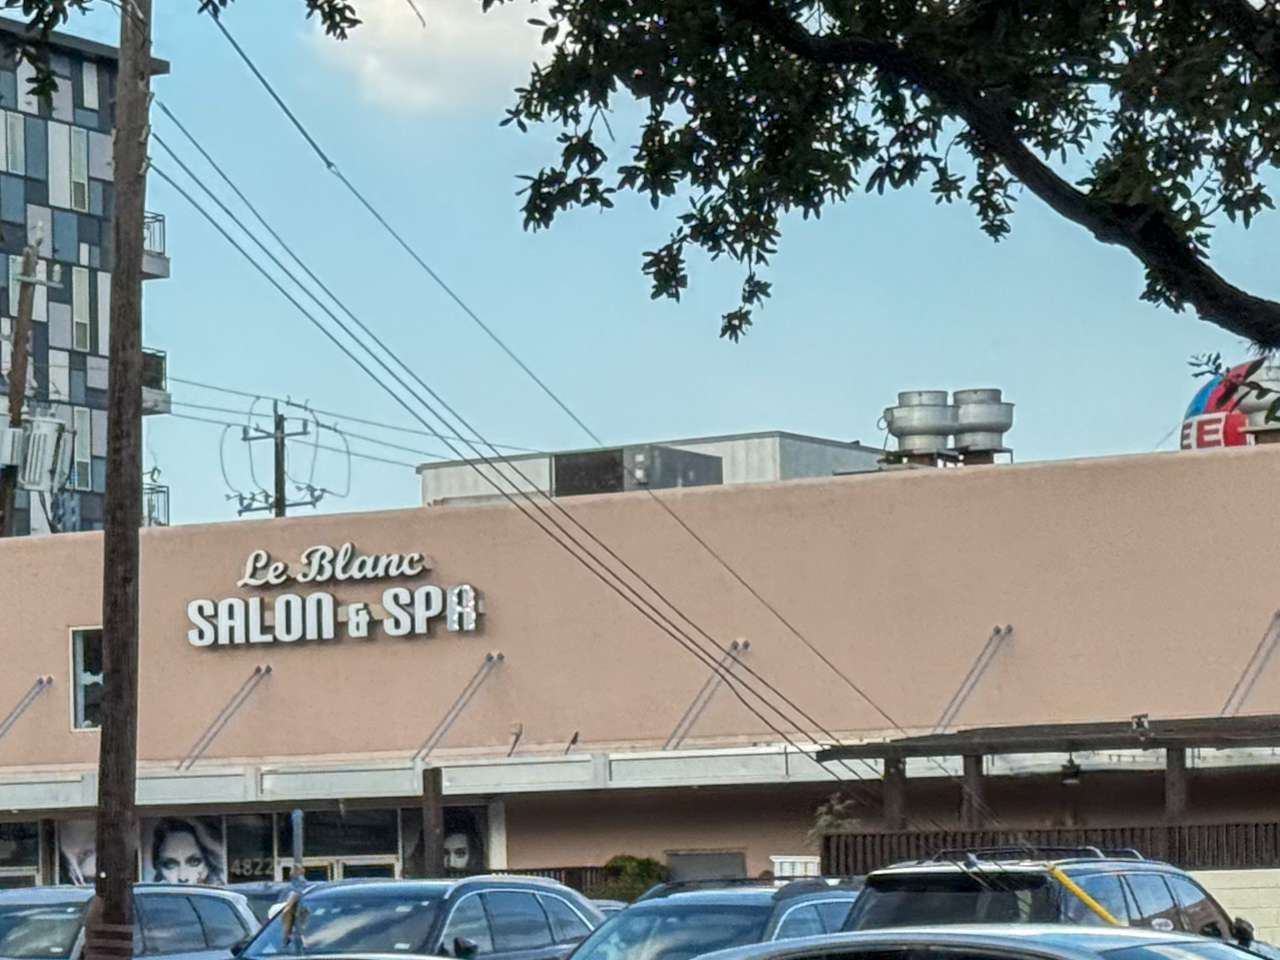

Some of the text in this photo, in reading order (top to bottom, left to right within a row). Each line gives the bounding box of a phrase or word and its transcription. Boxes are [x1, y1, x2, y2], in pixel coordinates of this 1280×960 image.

[236, 541, 426, 588] Le Blanc
[187, 583, 477, 647] SALON & SPA
[230, 858, 274, 876] 4822
